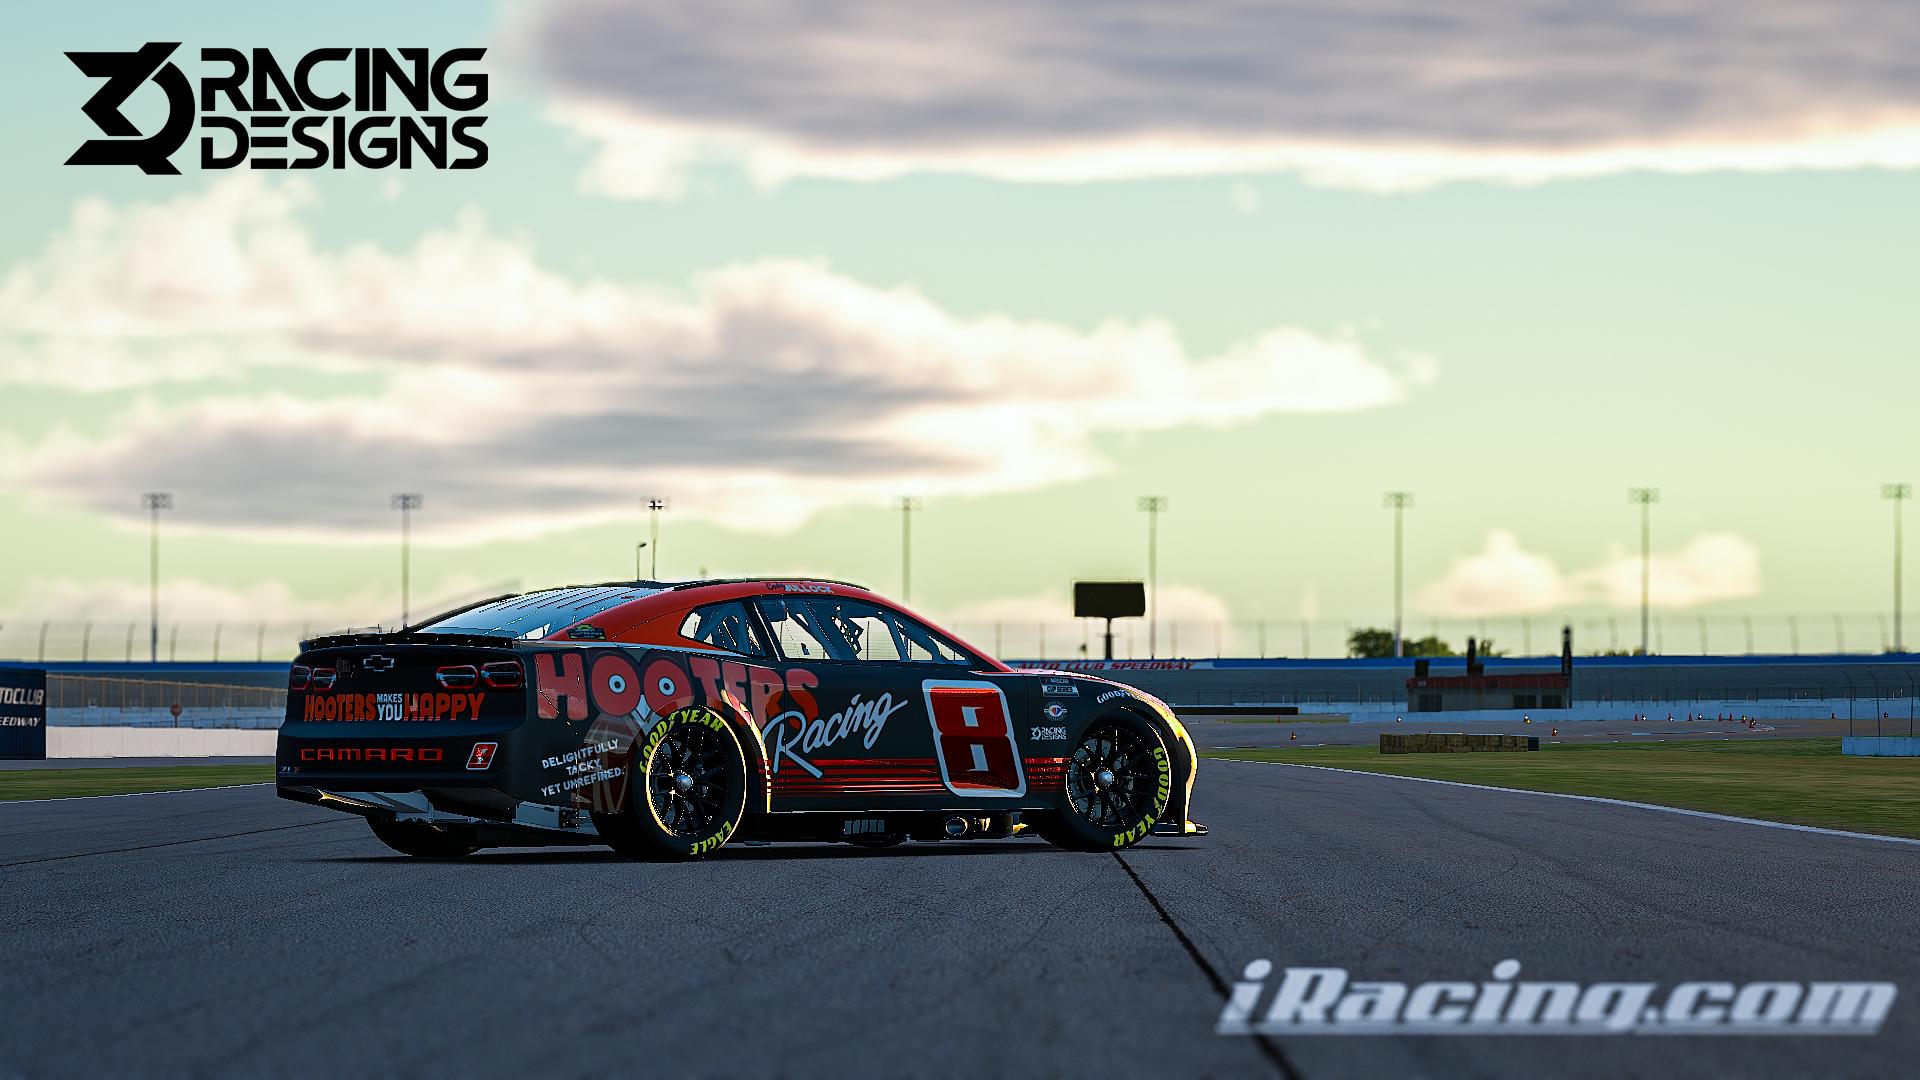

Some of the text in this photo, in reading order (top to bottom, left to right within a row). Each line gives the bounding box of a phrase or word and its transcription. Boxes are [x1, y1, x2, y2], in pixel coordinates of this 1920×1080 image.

[1066, 661, 1104, 670] CLUB
[1110, 661, 1194, 670] SPEEDWAY
[535, 652, 819, 729] HOOTERS
[303, 692, 485, 722] HOOTERS MAKES YOU HAPPY
[761, 691, 909, 779] Racing
[922, 679, 1026, 798] 8
[301, 748, 443, 761] CAMARO
[541, 738, 619, 770] DELIGHTFULLY
[540, 782, 562, 797] YET
[689, 820, 733, 856] EAGLE
